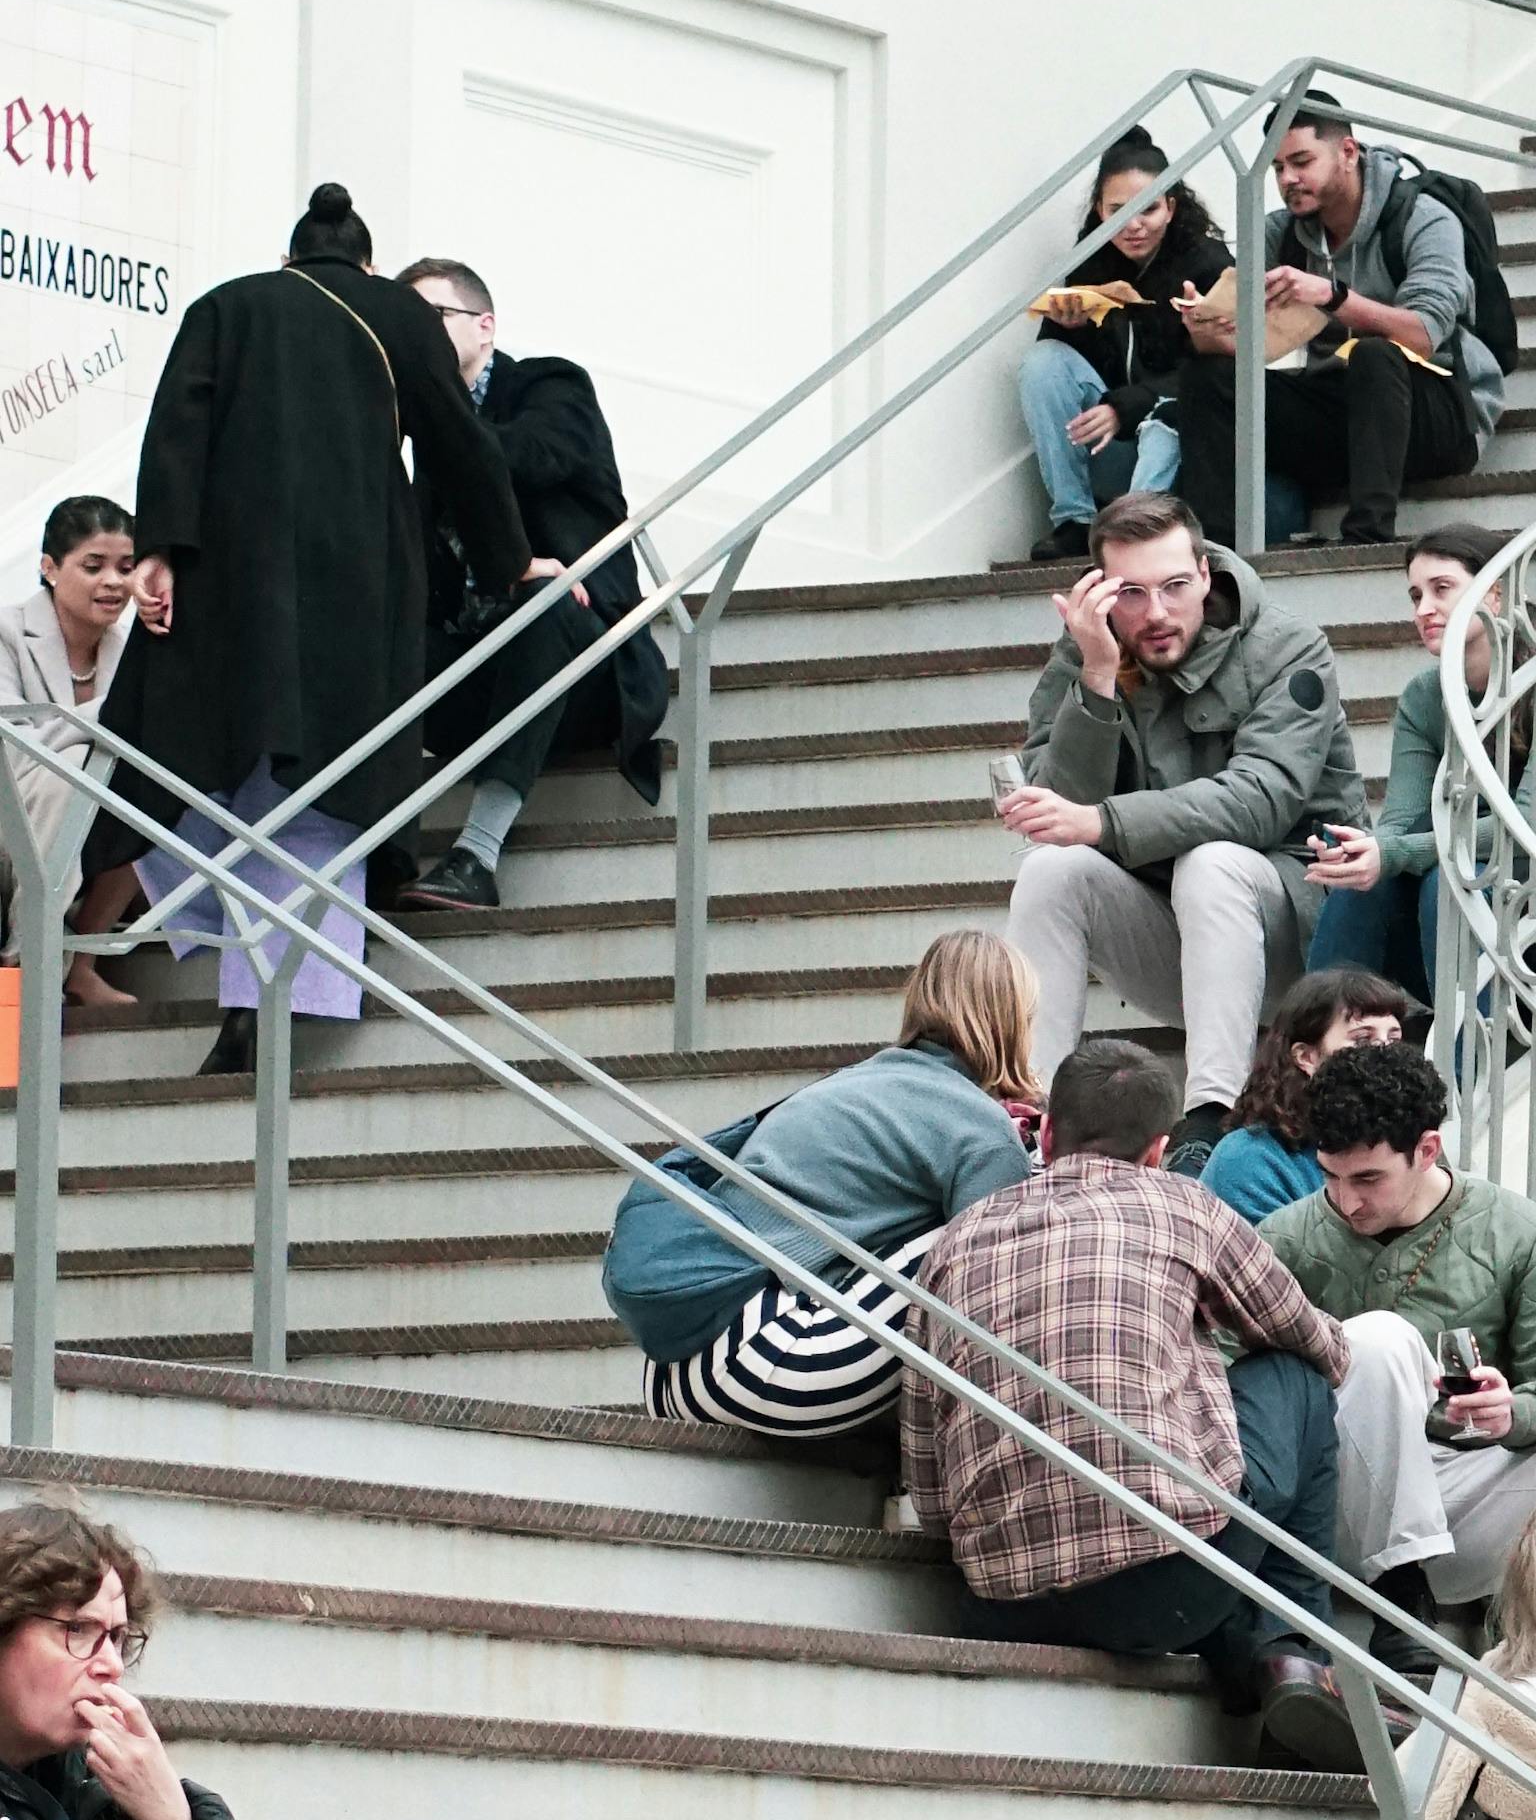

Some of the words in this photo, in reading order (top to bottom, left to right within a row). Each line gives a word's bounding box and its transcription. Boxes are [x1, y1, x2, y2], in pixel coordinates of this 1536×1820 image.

[3, 96, 98, 184] em
[0, 228, 169, 315] BAIXADORES
[0, 353, 79, 445] ONSECA
[82, 328, 125, 384] sarl
